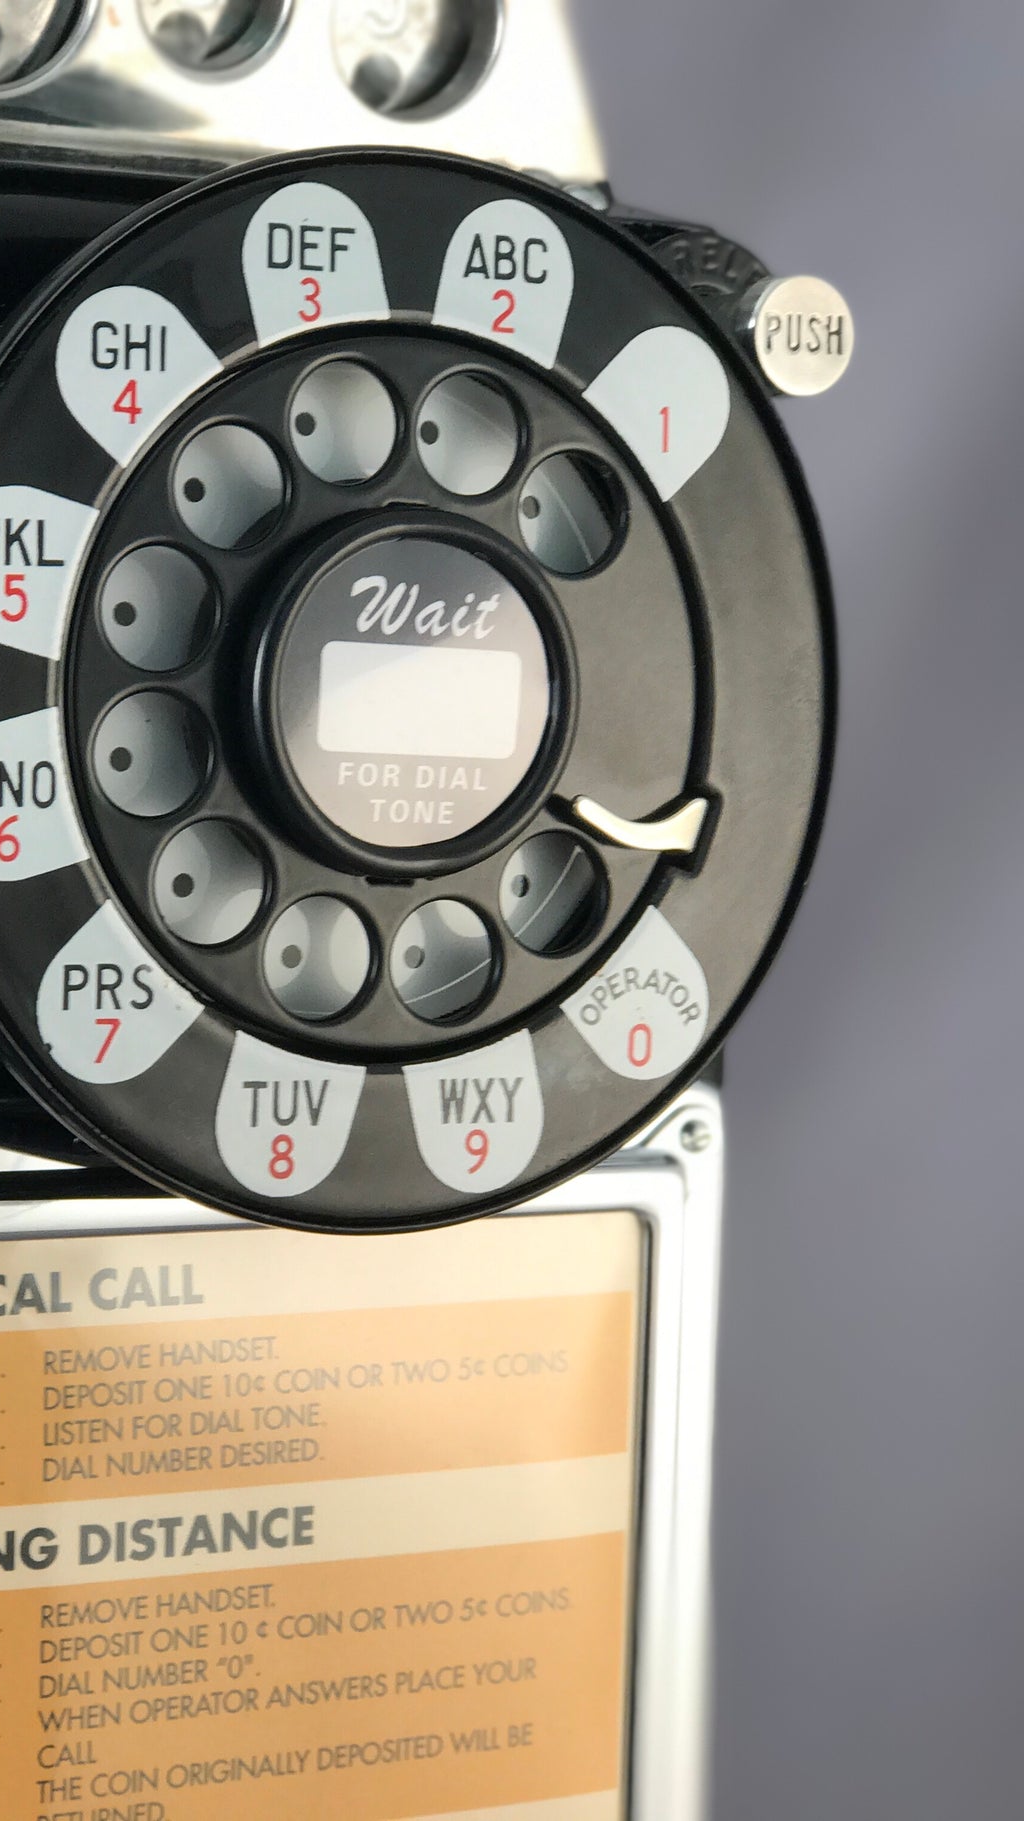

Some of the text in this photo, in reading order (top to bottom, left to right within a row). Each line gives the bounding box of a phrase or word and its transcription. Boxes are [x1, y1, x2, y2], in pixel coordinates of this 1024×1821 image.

[267, 222, 356, 272] DEF
[463, 233, 548, 283] ABC
[298, 277, 321, 322] 3
[492, 290, 516, 334] 2
[91, 321, 166, 371] GHI
[764, 313, 843, 355] PUSH
[112, 379, 142, 424] 4
[659, 406, 669, 453] 1
[0, 574, 29, 622] 5
[351, 575, 500, 639] Wait
[338, 762, 488, 790] FOR DIAL
[370, 800, 455, 824] TONE
[62, 963, 154, 1010] PRS
[579, 967, 701, 1026] OPERATOR
[93, 1018, 122, 1064] 7
[627, 1023, 652, 1067] 0
[242, 1079, 329, 1127] TUV
[439, 1077, 523, 1125] WXY
[268, 1134, 294, 1180] 8
[464, 1129, 489, 1174] 9
[89, 1264, 204, 1310] CALL
[43, 1344, 151, 1375] REMOVE
[159, 1335, 279, 1367] HANDSET.
[43, 1380, 146, 1411] DEPOSIT
[154, 1375, 213, 1403] ONE
[276, 1367, 340, 1394] COIN
[347, 1363, 383, 1389] OR
[391, 1358, 451, 1385] TWO
[43, 1417, 123, 1447] LISTEN
[132, 1414, 182, 1440] FOR
[190, 1410, 244, 1436] DIAL
[251, 1403, 327, 1431] TONE.
[41, 1455, 99, 1482] DIAL
[106, 1447, 212, 1477] NUMBER
[220, 1438, 325, 1469] DESIRED.
[78, 1505, 315, 1565] DISTANCE
[40, 1596, 148, 1628] REMOVE
[156, 1583, 275, 1616] HANDSET.
[40, 1631, 143, 1664] DEPOSIT
[150, 1625, 208, 1652] ONE
[277, 1611, 342, 1639] COIN
[349, 1607, 386, 1633] OR
[394, 1600, 453, 1628] TWO
[37, 1702, 121, 1733] WHEN
[129, 1687, 259, 1725] OPERATOR
[266, 1673, 387, 1709] ANSWERS
[395, 1665, 465, 1693] PLACE
[473, 1658, 536, 1685] YOUR
[39, 1673, 94, 1699] DIAL
[102, 1660, 208, 1692] NUMBER
[36, 1777, 82, 1804] THE
[91, 1767, 159, 1797] COIN
[166, 1750, 310, 1787] ORIGINALLY
[317, 1734, 444, 1771] DEPOSITED
[449, 1727, 501, 1752] WILL
[508, 1723, 534, 1748] BE
[37, 1740, 97, 1769] CALL
